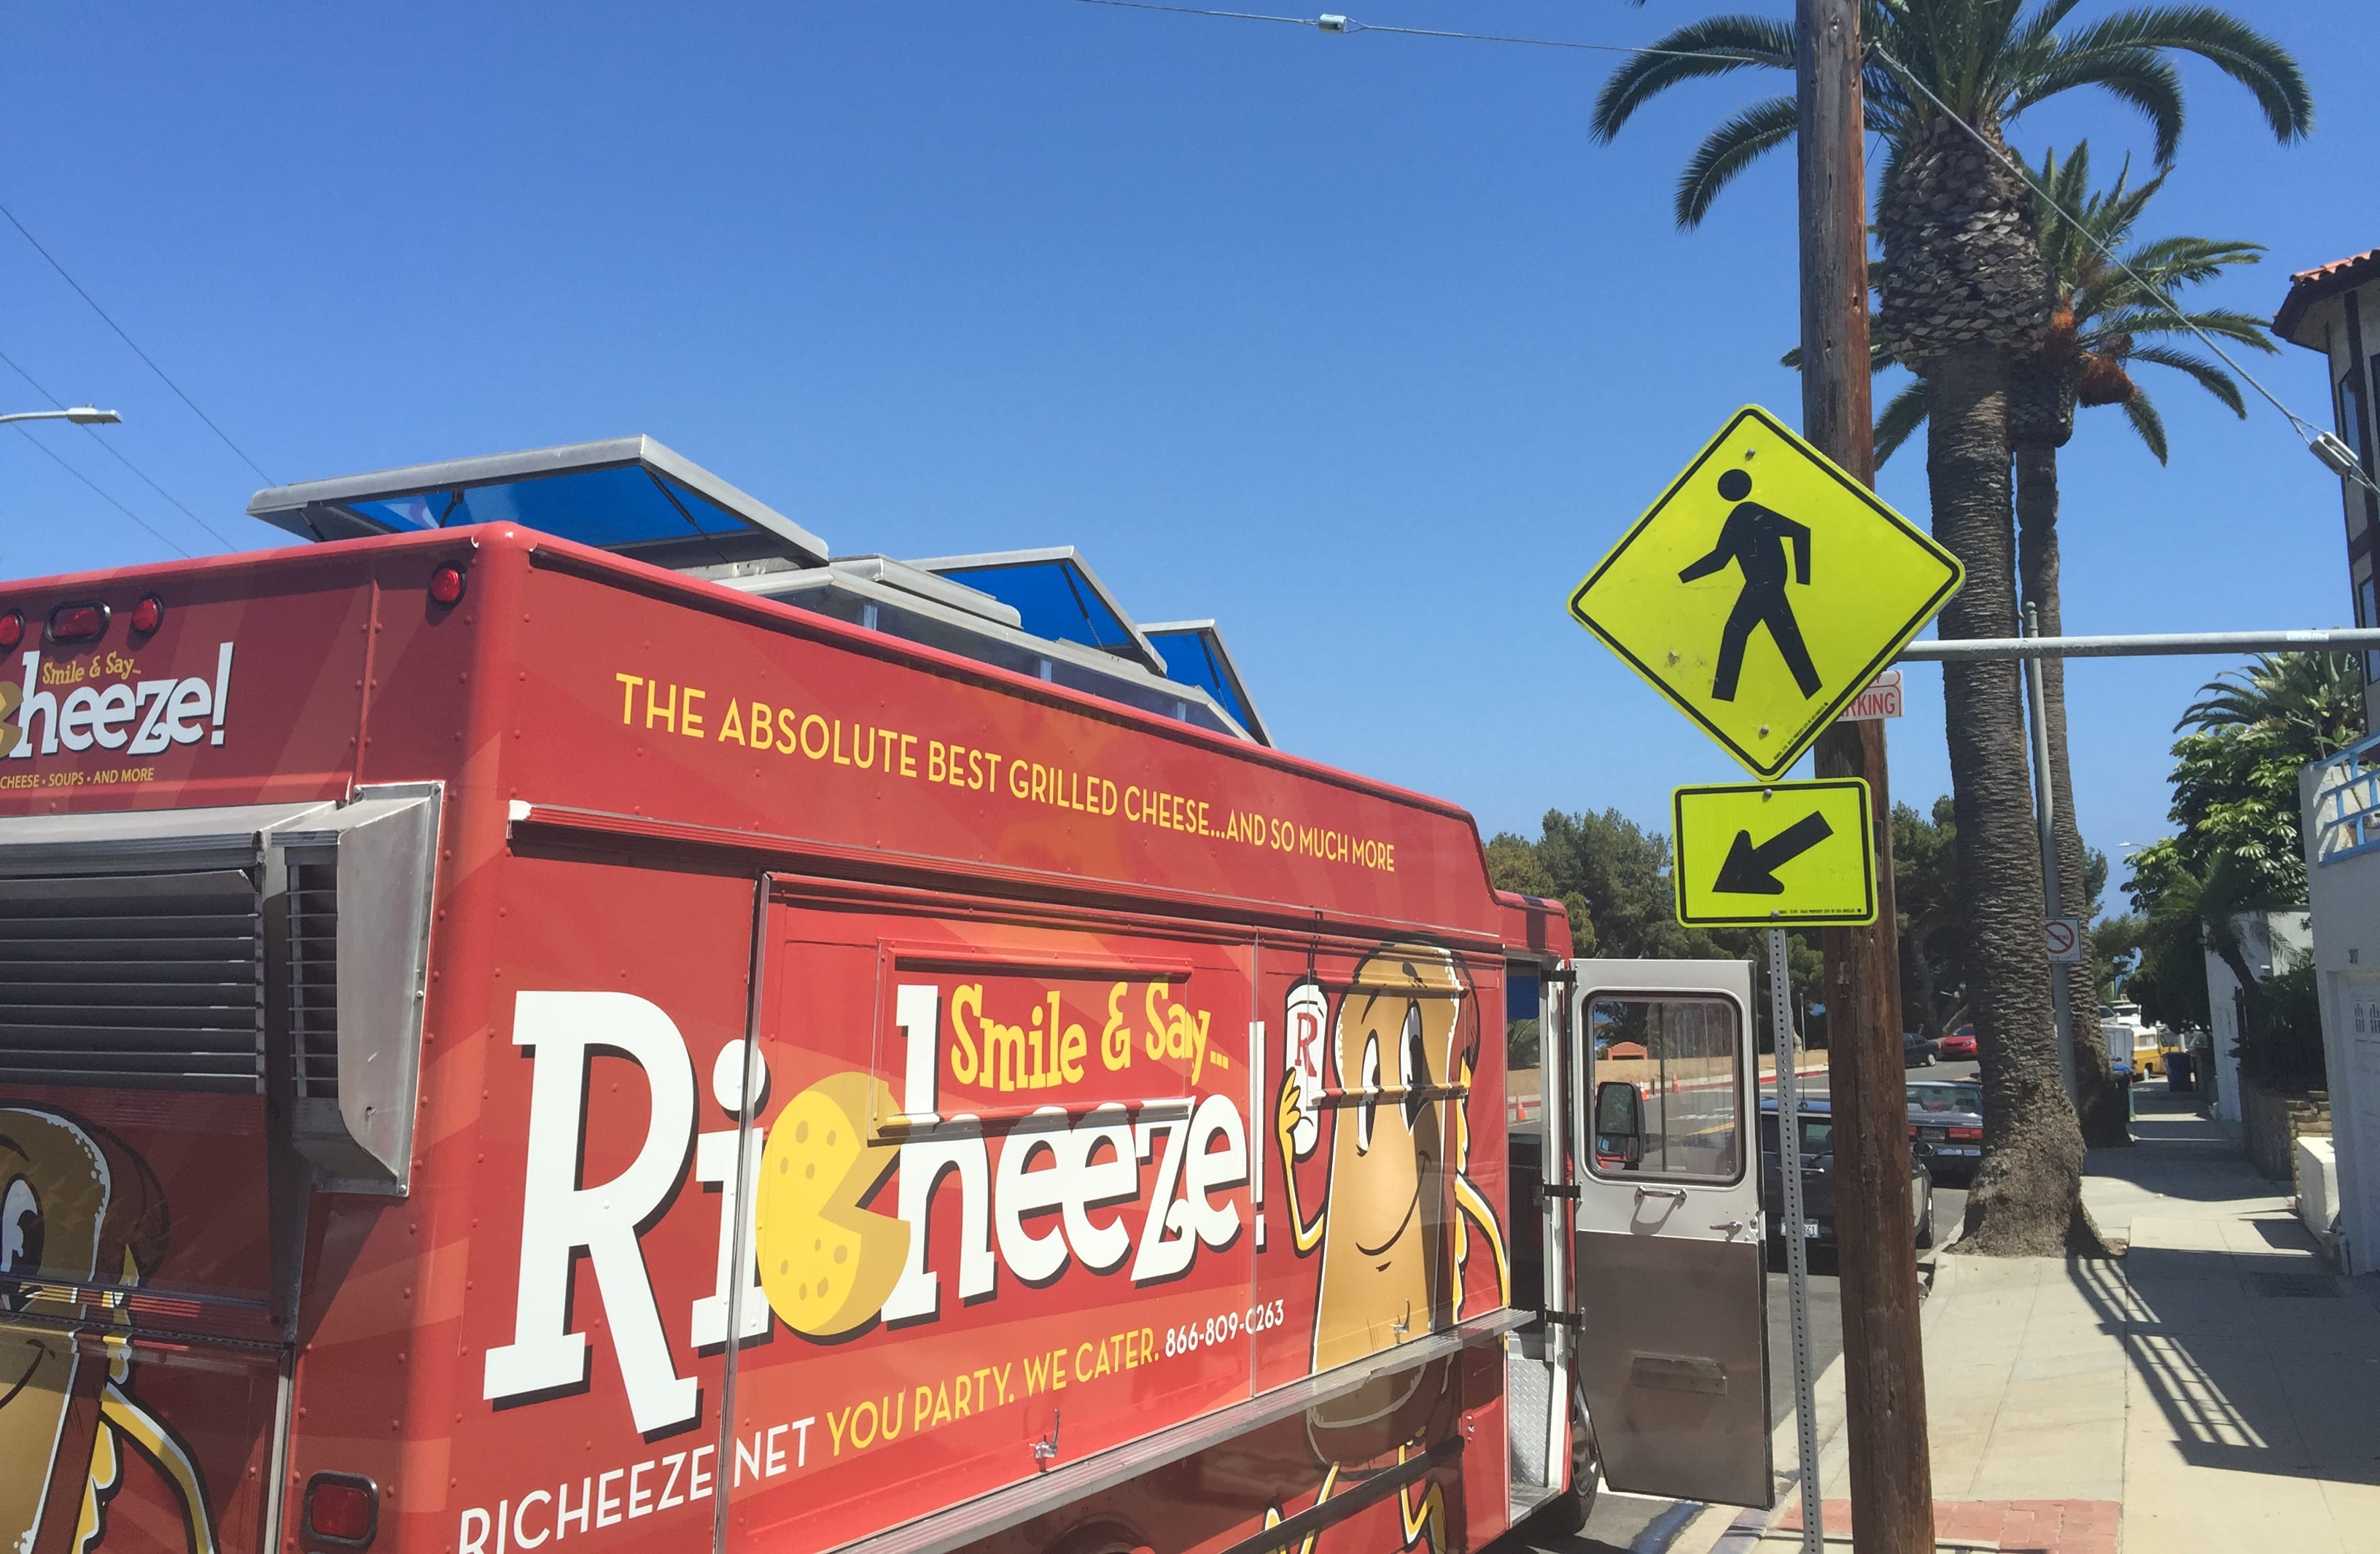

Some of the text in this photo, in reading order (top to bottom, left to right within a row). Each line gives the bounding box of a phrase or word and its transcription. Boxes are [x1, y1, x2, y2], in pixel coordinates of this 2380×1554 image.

[42, 661, 85, 685] Smile
[89, 656, 101, 678] &
[0, 767, 155, 789] CHEESE SOUPS AND MORE
[616, 673, 705, 738] THE
[718, 697, 917, 777] ABSOLUTE
[928, 740, 1001, 792] BEST
[1009, 759, 1117, 815] GRILLED
[1271, 820, 1295, 852] SO
[1299, 825, 1348, 863] MUCH
[1352, 836, 1394, 871] MORE
[951, 983, 1087, 1092] Smile
[1101, 982, 1132, 1071] &
[1295, 1012, 1318, 1077] R
[459, 1298, 1285, 1554] RICHEEZE NET YOU PARTY. WE CATER. 866-809-0263
